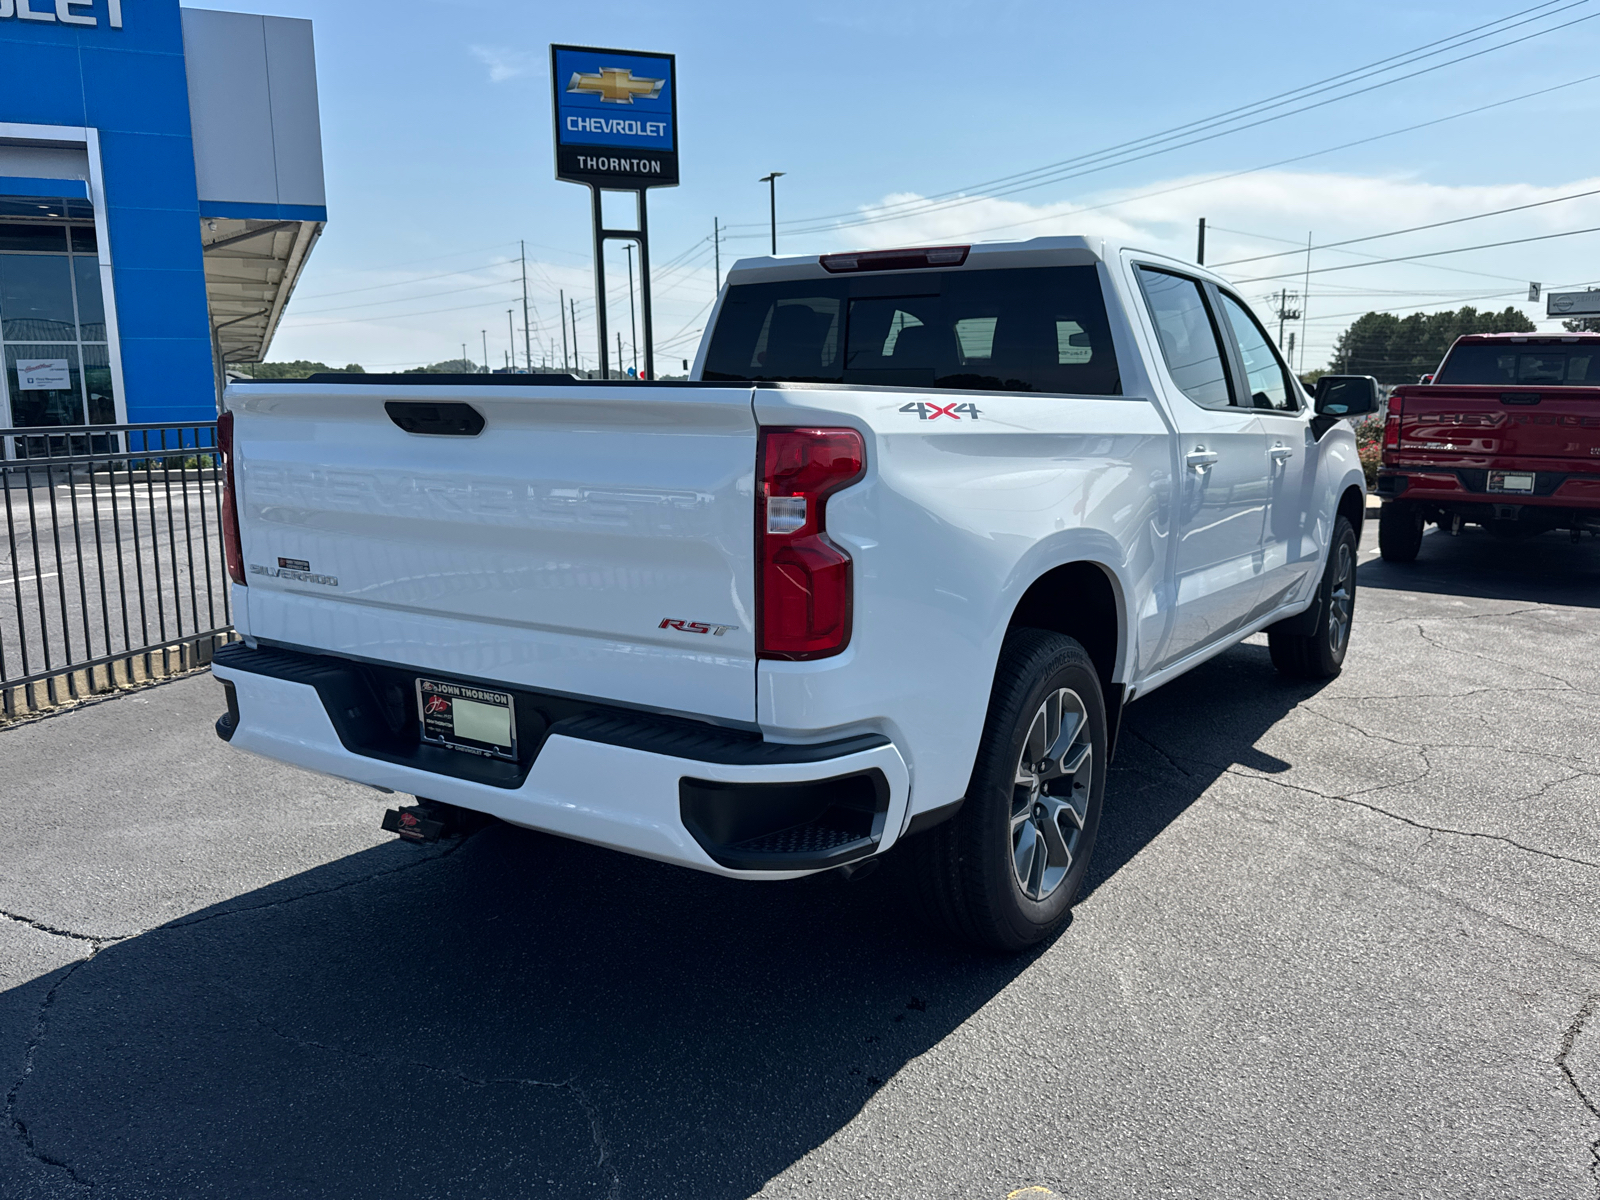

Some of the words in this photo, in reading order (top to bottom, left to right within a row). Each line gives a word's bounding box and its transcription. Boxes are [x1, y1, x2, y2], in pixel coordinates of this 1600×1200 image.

[0, 0, 122, 28] LET
[567, 116, 666, 137] CHEVROLET
[577, 156, 661, 174] THORNTON
[249, 563, 338, 587] SILVERADO
[658, 617, 739, 637] RST
[437, 684, 460, 696] JOHN
[461, 688, 508, 704] THORNTON
